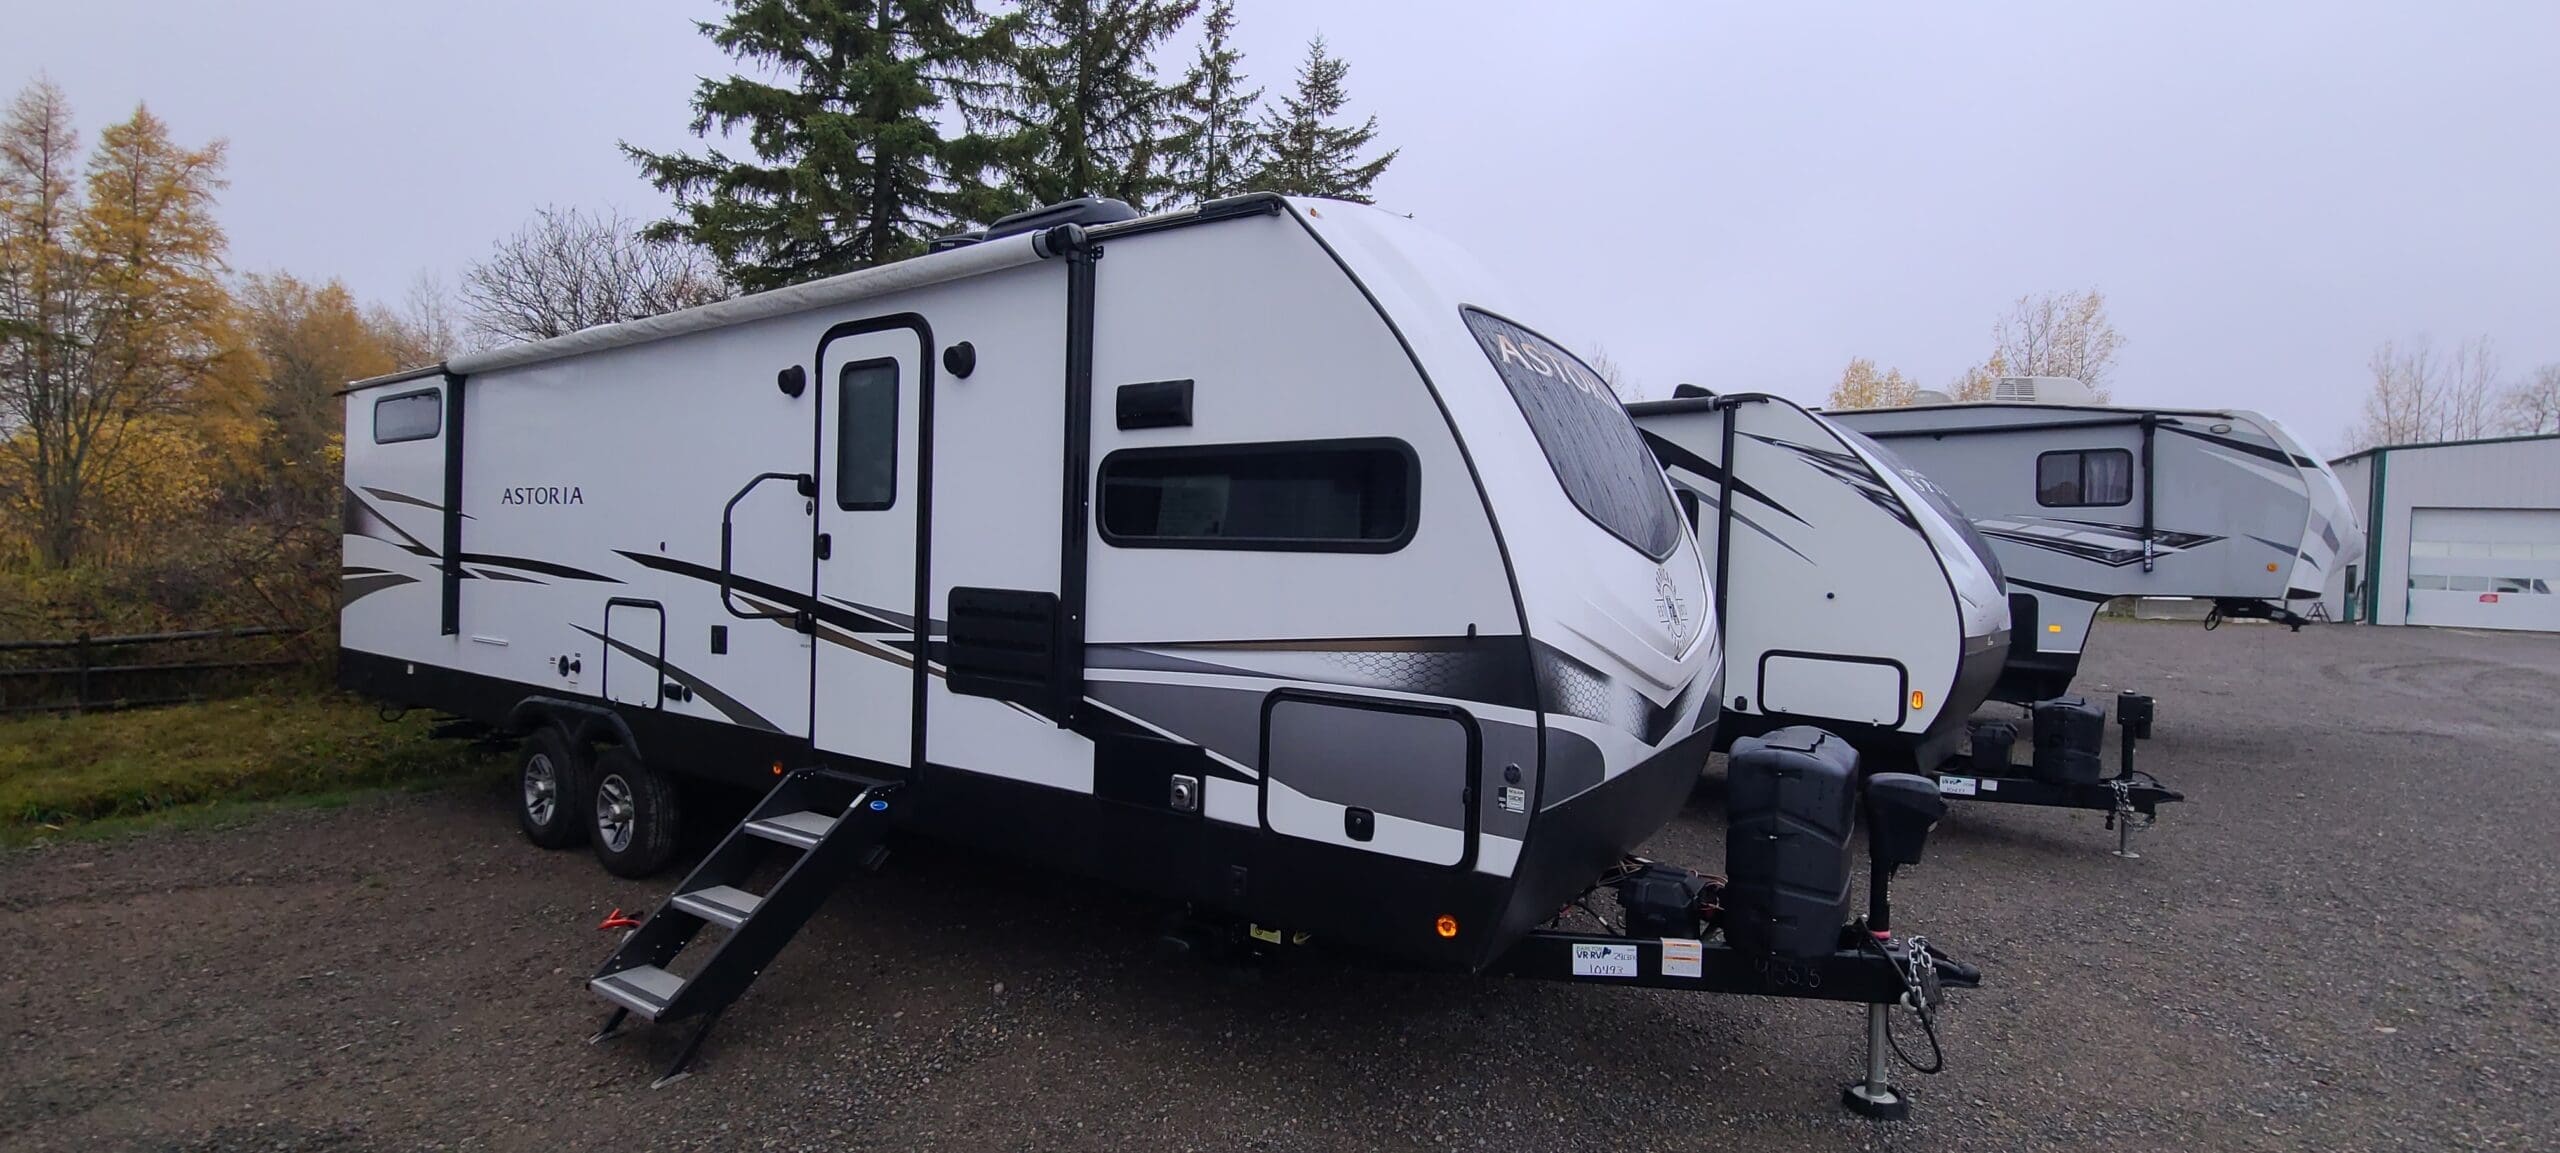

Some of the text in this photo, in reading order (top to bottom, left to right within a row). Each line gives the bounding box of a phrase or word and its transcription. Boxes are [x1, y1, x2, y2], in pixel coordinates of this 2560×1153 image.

[501, 486, 584, 505] ASTORIA
[1576, 951, 1602, 960] VR RV
